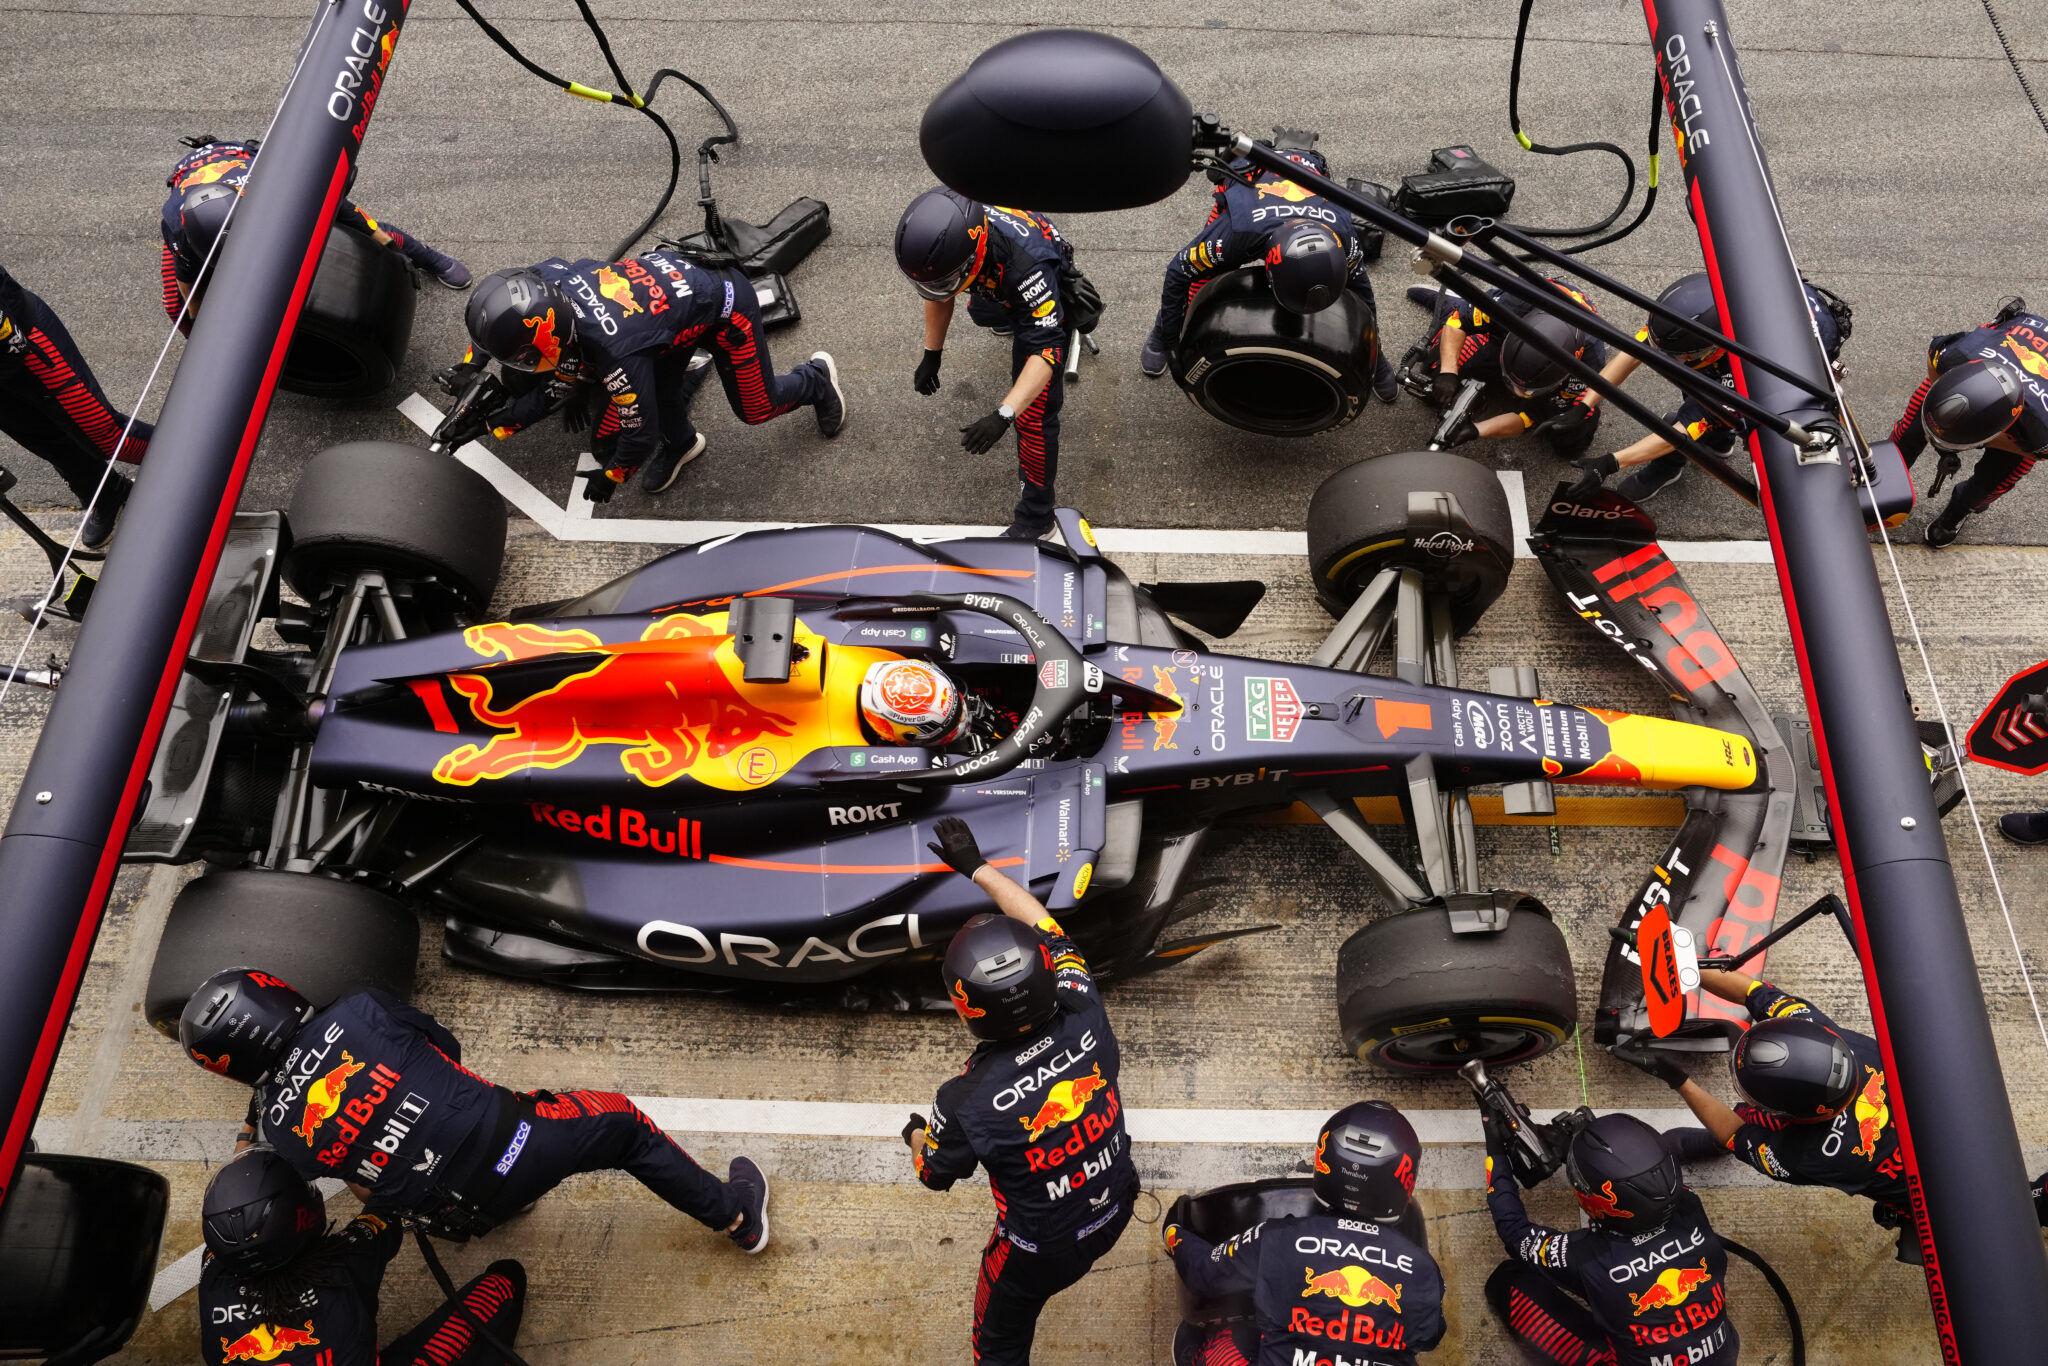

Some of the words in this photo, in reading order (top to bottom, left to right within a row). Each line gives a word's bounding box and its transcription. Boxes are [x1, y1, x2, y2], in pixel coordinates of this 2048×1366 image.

[327, 0, 387, 121] ORACLE
[1665, 33, 1711, 155] ORACLE
[982, 204, 1030, 237] ORAC
[1251, 204, 1338, 224] ORACLE
[631, 275, 672, 316] Red
[650, 258, 693, 299] Mobil
[1021, 277, 1048, 302] ROKT
[568, 273, 619, 336] ORACLE
[720, 280, 735, 319] sparco
[1978, 346, 2048, 412] ORACLE
[1551, 502, 1623, 521] Claro
[1413, 537, 1446, 551] Hard
[1446, 537, 1475, 553] Rock
[963, 593, 1004, 612] BYBIT
[1063, 571, 1075, 614] Walmart
[861, 627, 881, 638] App
[883, 628, 906, 638] Cash
[1012, 613, 1046, 649] ORACLE
[1591, 541, 1740, 692] Bull
[1013, 653, 1036, 664] obil
[1046, 660, 1056, 688] HEUER
[1056, 661, 1066, 687] TAG
[1012, 705, 1044, 748] telcel
[1209, 664, 1226, 752] ORACLE
[1250, 681, 1267, 736] TAG
[1275, 680, 1298, 738] HEUER
[1452, 698, 1462, 719] App
[1515, 705, 1528, 737] ARCTIC
[1523, 709, 1537, 733] WOLF
[1121, 711, 1145, 750] Bull
[1453, 719, 1465, 747] Cash
[1471, 711, 1489, 749] CDW
[1496, 703, 1514, 752] zoom
[1540, 708, 1557, 757] PIRELLI
[1576, 726, 1592, 760] Mobil
[870, 754, 895, 764] Cash
[897, 754, 919, 765] App
[954, 750, 1000, 777] zoom
[1189, 767, 1290, 791] BYBIT
[527, 800, 613, 841] Red
[619, 807, 702, 860] Bull
[828, 802, 902, 826] ROKT
[1058, 798, 1071, 847] Walmart
[636, 912, 932, 970] ORACL
[247, 972, 297, 993] Re
[1661, 928, 1679, 999] BRAKES
[1001, 989, 1030, 1004] Therabody
[1057, 980, 1089, 994] Mobil
[1015, 1036, 1055, 1066] sparco
[270, 1021, 345, 1127] ORACLE
[992, 1029, 1097, 1112] ORACLE
[316, 1113, 360, 1169] Red
[348, 1063, 402, 1127] Bull
[1025, 1127, 1086, 1173] Red
[1083, 1086, 1120, 1145] Bull
[356, 1119, 412, 1183] Mobil
[496, 1121, 532, 1175] sparco
[1046, 1147, 1113, 1201] Mobil
[1341, 1166, 1369, 1182] Therabody
[1337, 1218, 1380, 1236] sparco
[1295, 1235, 1414, 1275] ORACLE
[1550, 1234, 1562, 1269] ROKT
[1609, 1226, 1705, 1284] ORACLE
[1288, 1307, 1350, 1342] Red
[1629, 1309, 1688, 1346] Red
[1685, 1281, 1726, 1330] Bull
